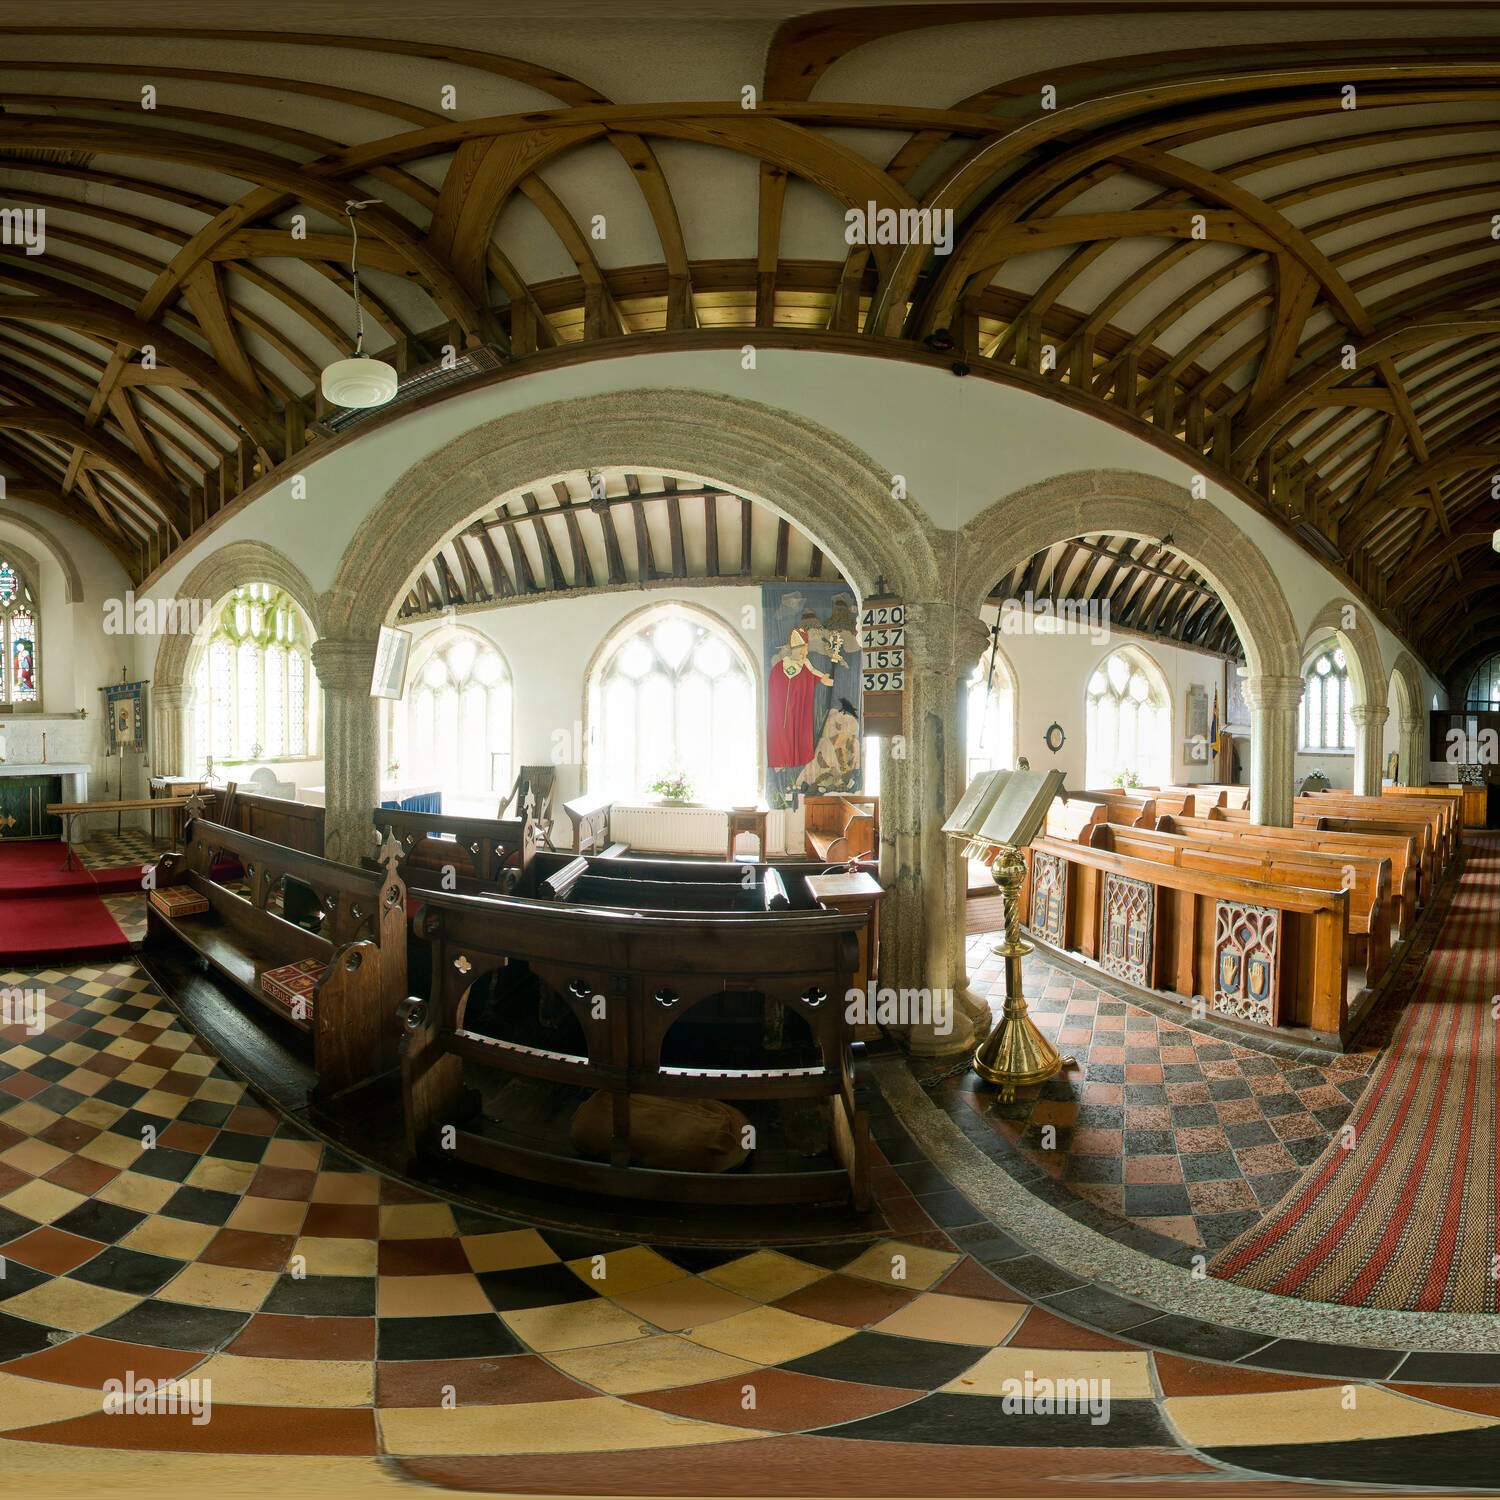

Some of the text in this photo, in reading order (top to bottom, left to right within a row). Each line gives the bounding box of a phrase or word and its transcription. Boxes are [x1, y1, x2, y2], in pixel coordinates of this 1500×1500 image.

[863, 607, 902, 626] 420
[864, 629, 902, 647] 437
[866, 651, 902, 668] 153
[863, 673, 902, 690] 395
